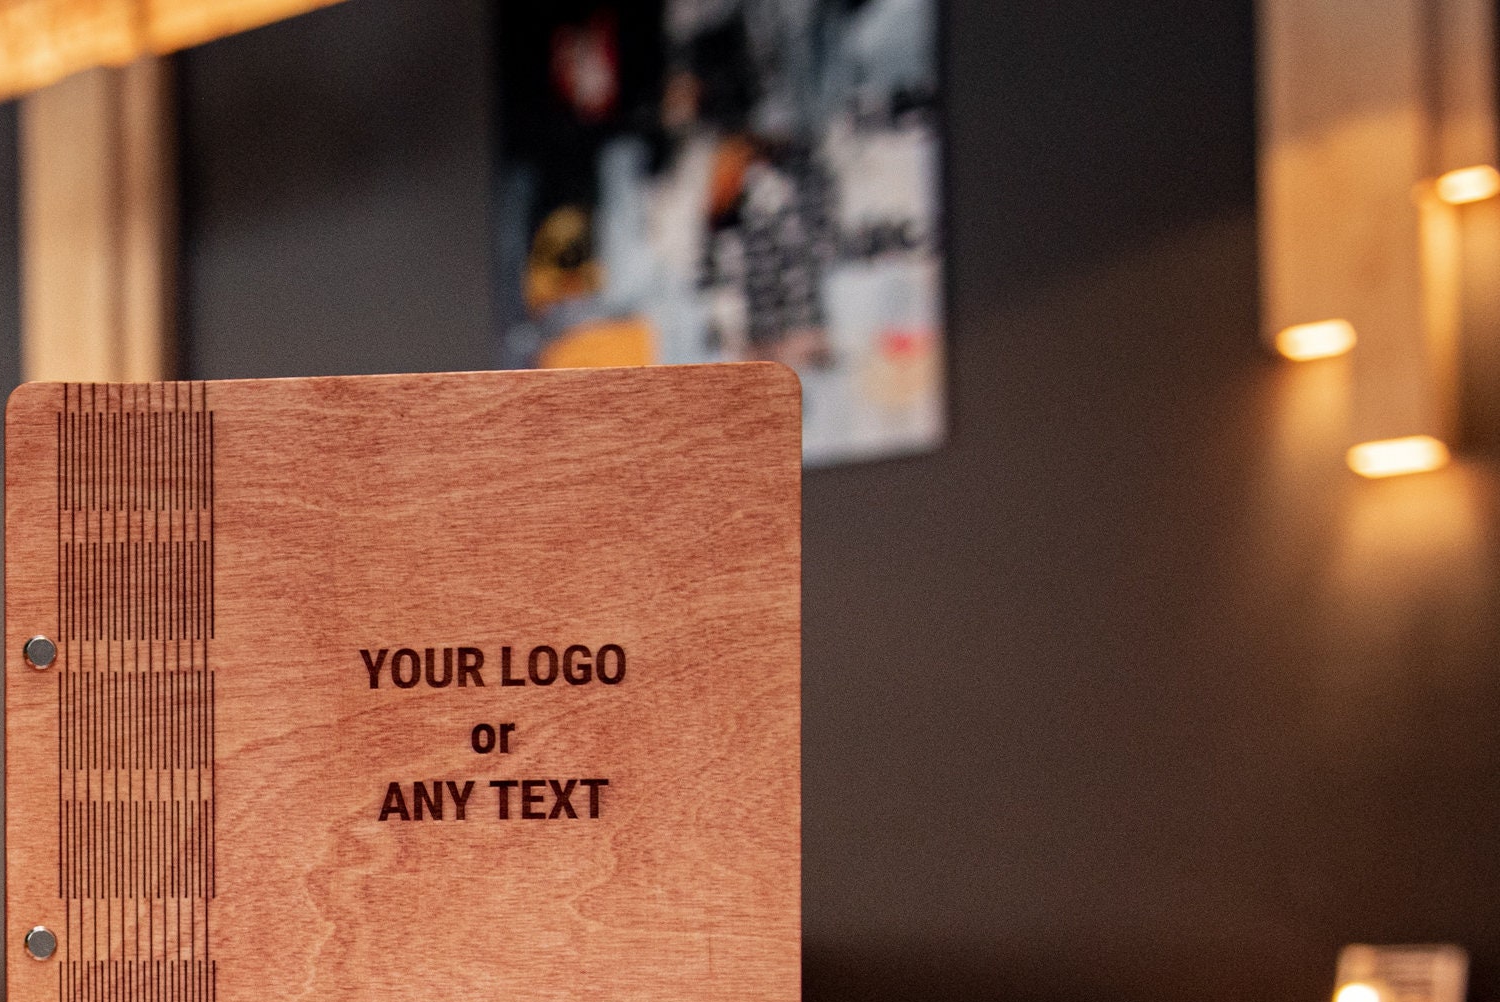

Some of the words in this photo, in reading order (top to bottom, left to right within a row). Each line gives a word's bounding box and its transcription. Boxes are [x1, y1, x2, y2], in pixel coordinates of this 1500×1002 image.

[360, 647, 485, 689] YOUR
[501, 644, 627, 686] LOGO
[471, 723, 515, 754] or
[378, 780, 475, 821] ANY
[490, 779, 609, 820] TEXT
